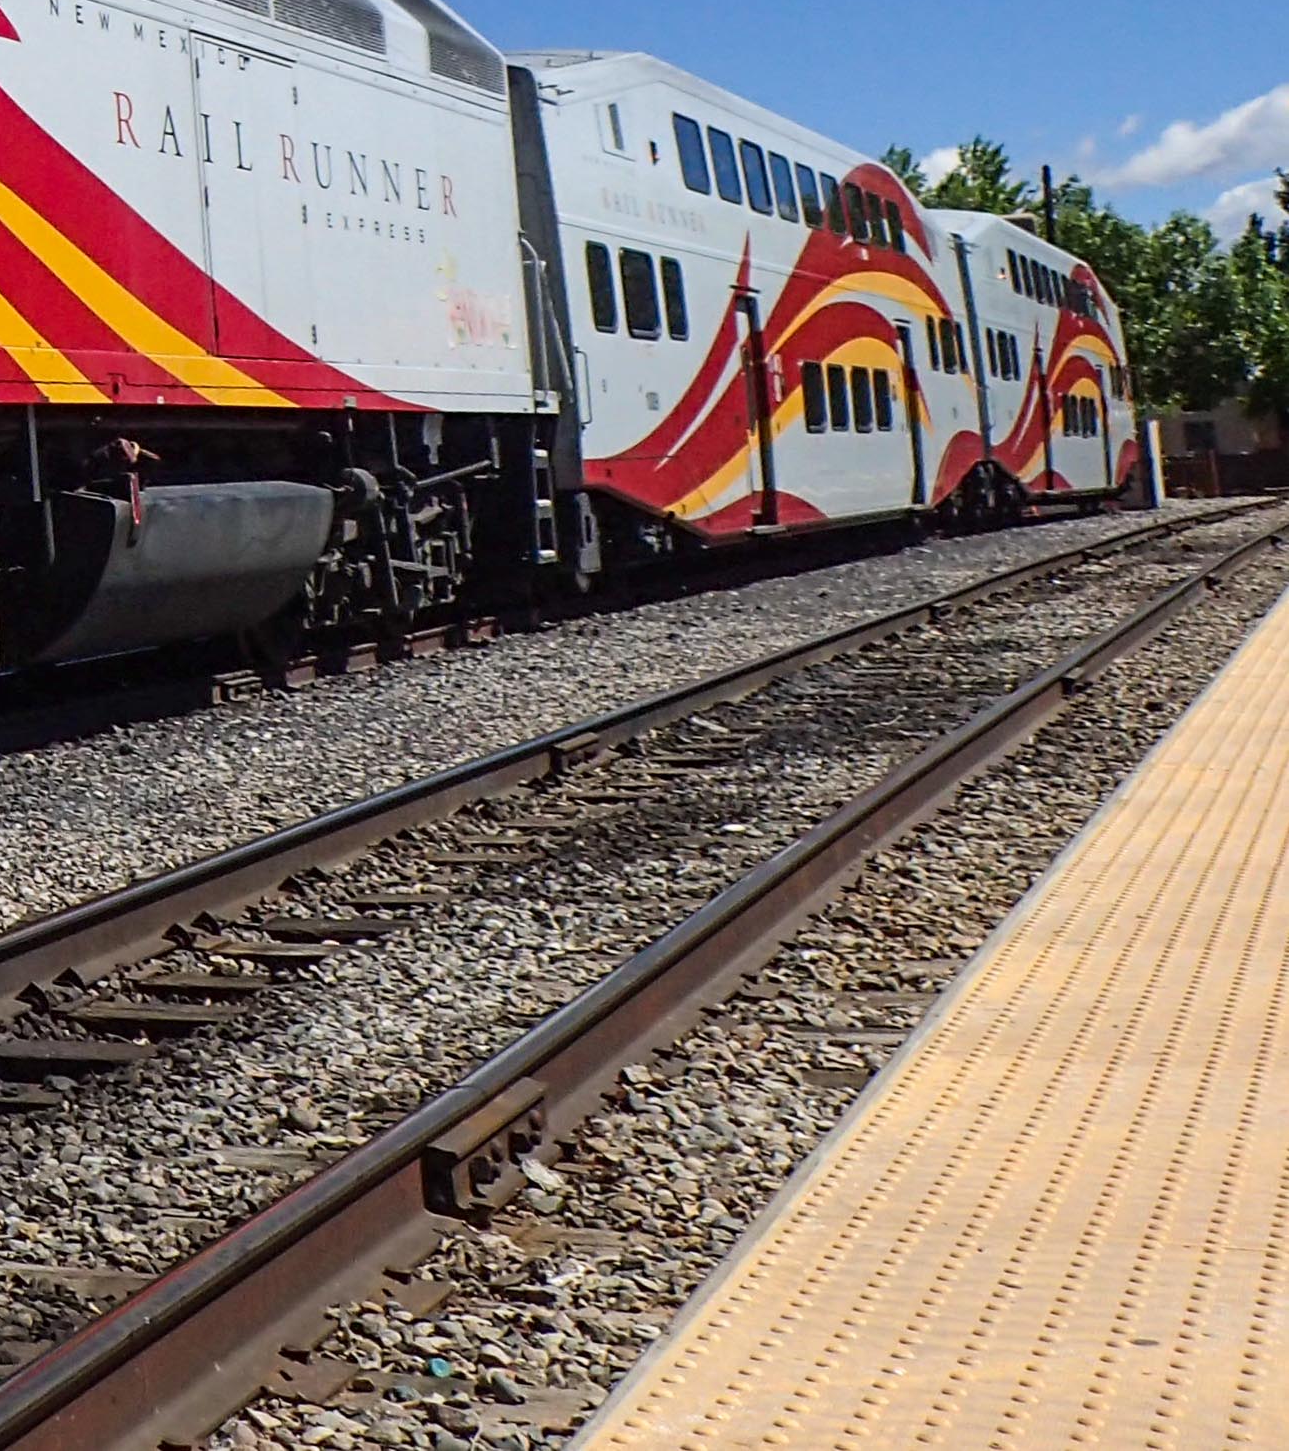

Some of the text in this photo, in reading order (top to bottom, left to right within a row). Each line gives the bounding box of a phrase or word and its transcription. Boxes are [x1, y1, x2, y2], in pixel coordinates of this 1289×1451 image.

[133, 22, 251, 71] MEXICO
[110, 91, 458, 219] RAIL RUNNER
[326, 212, 426, 243] EXPRESS
